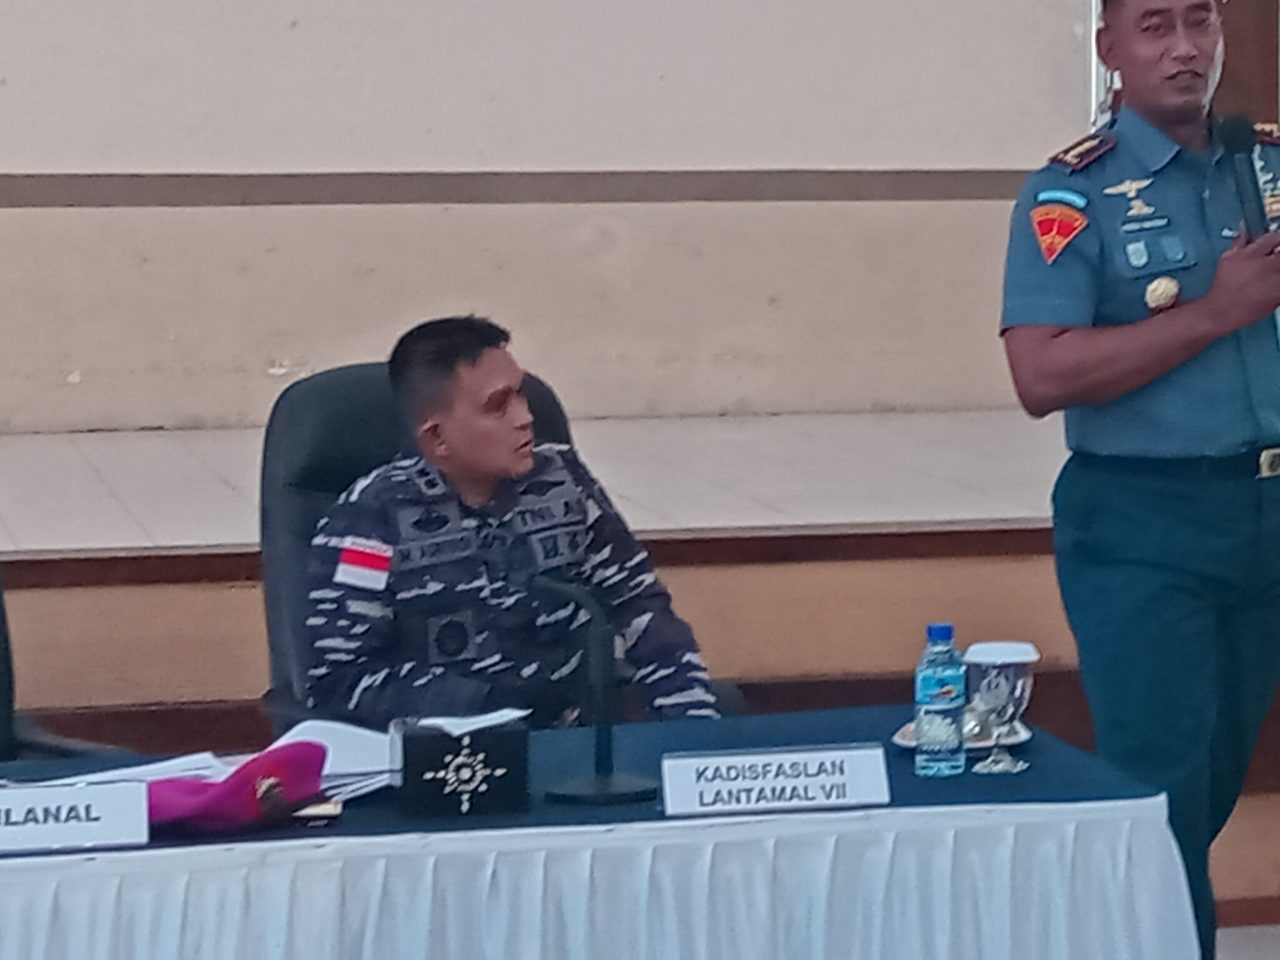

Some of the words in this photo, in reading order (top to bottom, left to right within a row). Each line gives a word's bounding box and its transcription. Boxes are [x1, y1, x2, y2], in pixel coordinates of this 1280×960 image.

[694, 759, 846, 784] KADISFASLAN
[698, 784, 817, 808] LANTAMAL
[820, 782, 848, 801] VII
